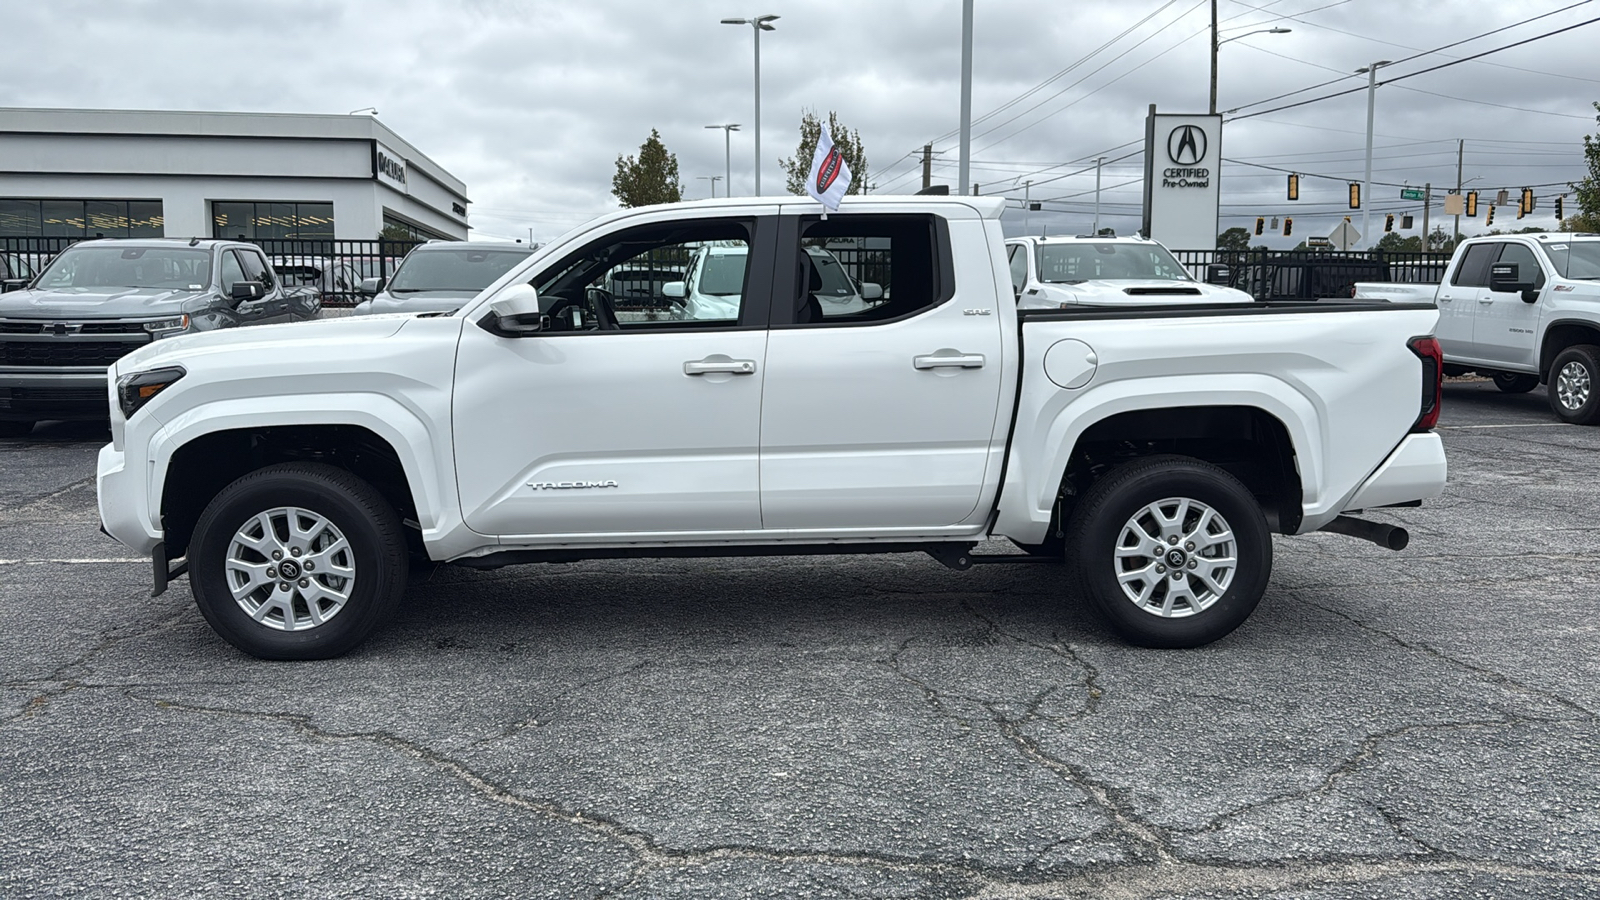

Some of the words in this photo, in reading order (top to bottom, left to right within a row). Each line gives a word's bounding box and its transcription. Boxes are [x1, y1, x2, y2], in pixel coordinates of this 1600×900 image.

[1163, 168, 1209, 178] CERTIFIED
[1162, 178, 1209, 188] Pre-Owned
[526, 479, 618, 490] TACOMA
